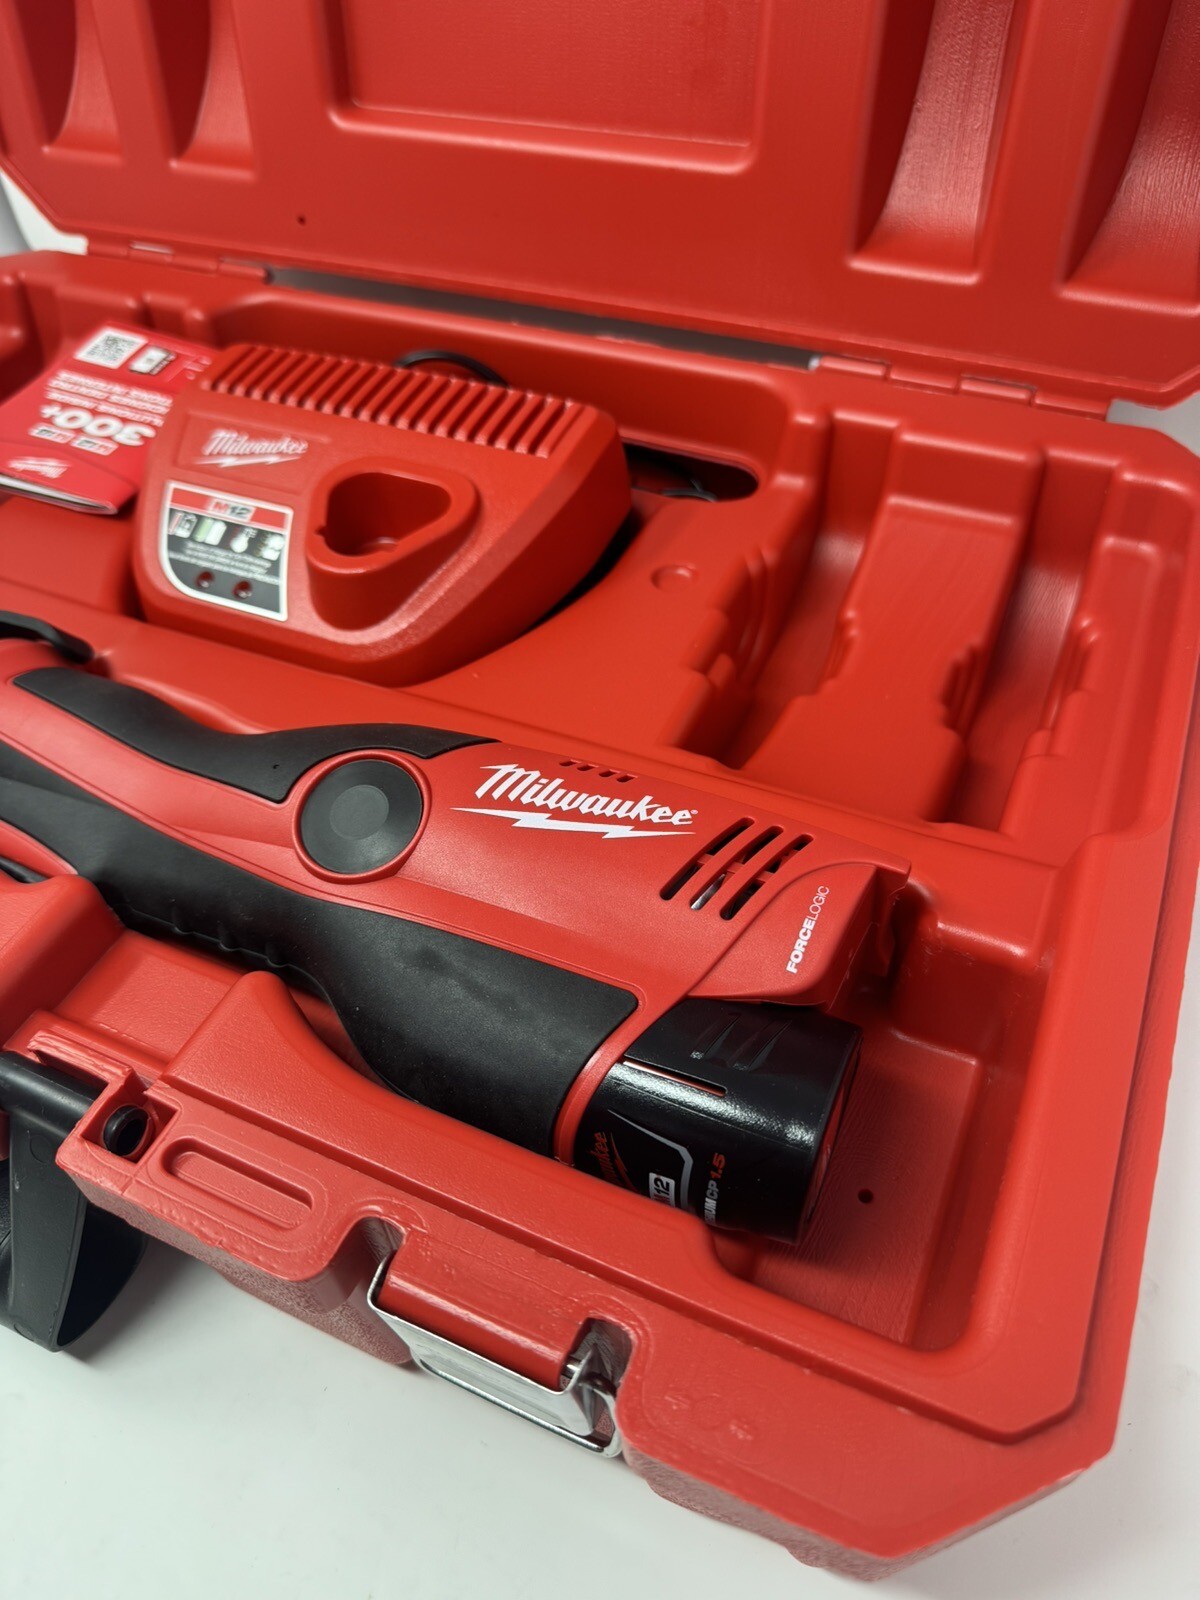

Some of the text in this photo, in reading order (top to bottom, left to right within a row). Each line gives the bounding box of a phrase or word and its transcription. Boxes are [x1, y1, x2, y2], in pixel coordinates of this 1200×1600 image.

[40, 404, 157, 446] 300+
[202, 429, 309, 455] Milwaukee
[211, 500, 252, 517] M12
[475, 763, 698, 826] Milwaukee
[786, 886, 830, 974] FORCELOGIC
